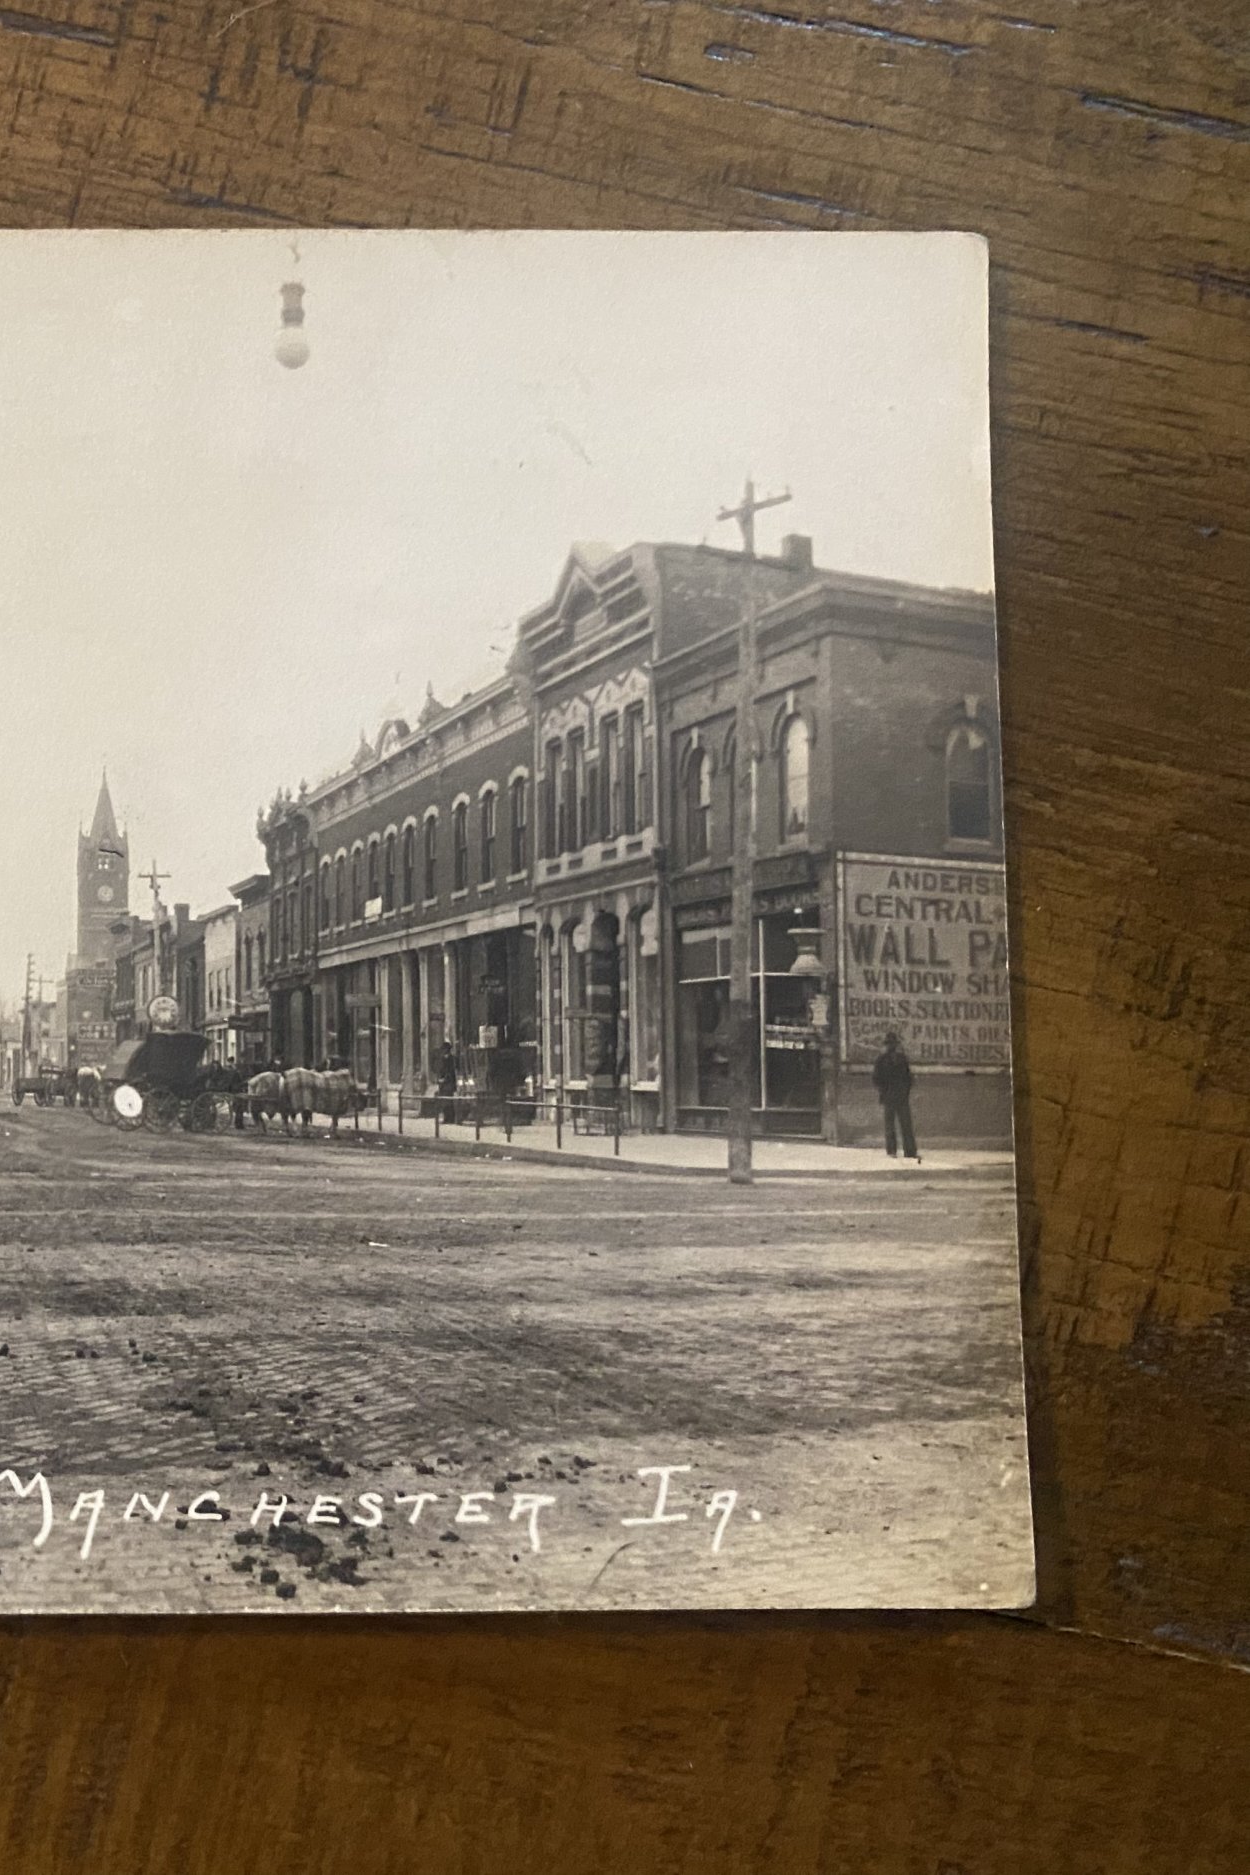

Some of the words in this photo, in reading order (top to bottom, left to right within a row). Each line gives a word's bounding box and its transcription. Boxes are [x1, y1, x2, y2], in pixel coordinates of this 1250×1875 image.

[854, 893, 993, 925] CENTRAL
[848, 923, 951, 967] WALL
[862, 968, 956, 994] WINDOW
